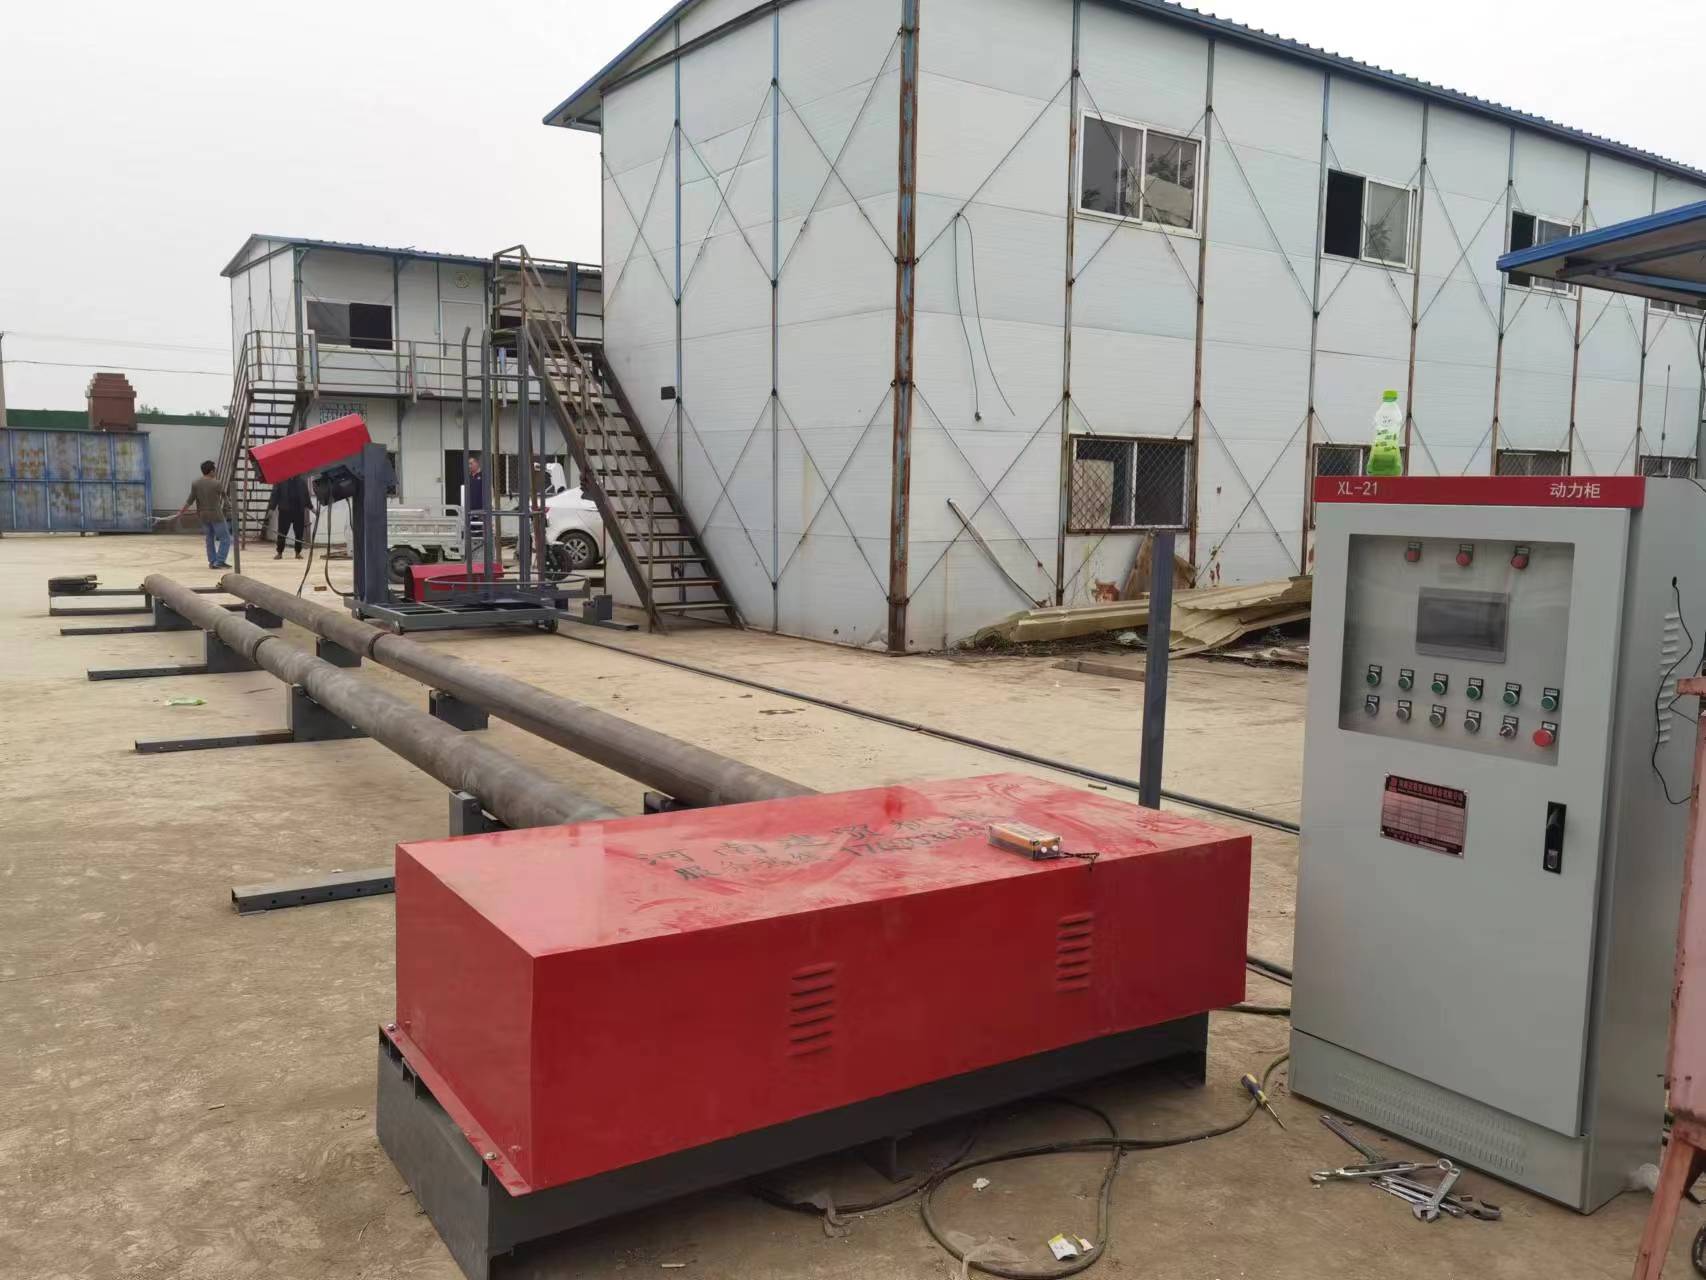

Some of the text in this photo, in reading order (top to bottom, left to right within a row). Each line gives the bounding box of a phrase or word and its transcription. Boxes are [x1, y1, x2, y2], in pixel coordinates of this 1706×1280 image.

[1337, 481, 1378, 496] XL-21
[1549, 482, 1601, 499] 动力柜
